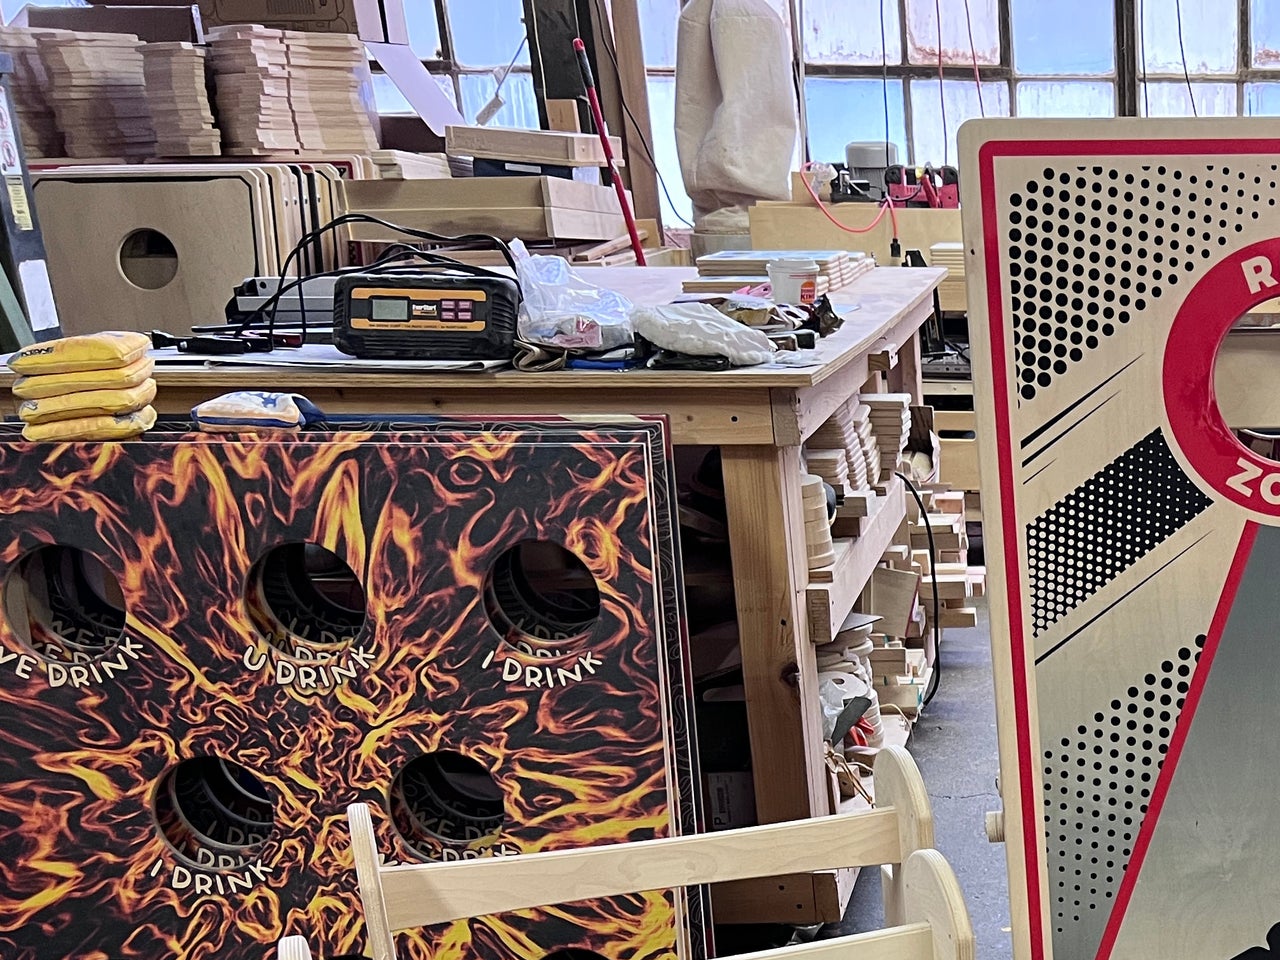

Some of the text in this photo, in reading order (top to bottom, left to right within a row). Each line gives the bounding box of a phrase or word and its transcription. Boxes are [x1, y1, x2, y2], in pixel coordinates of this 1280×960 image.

[47, 637, 144, 688] DRINK
[243, 646, 375, 688] U DRINK
[482, 650, 603, 688] I DRINK
[151, 859, 274, 895] I DRINK
